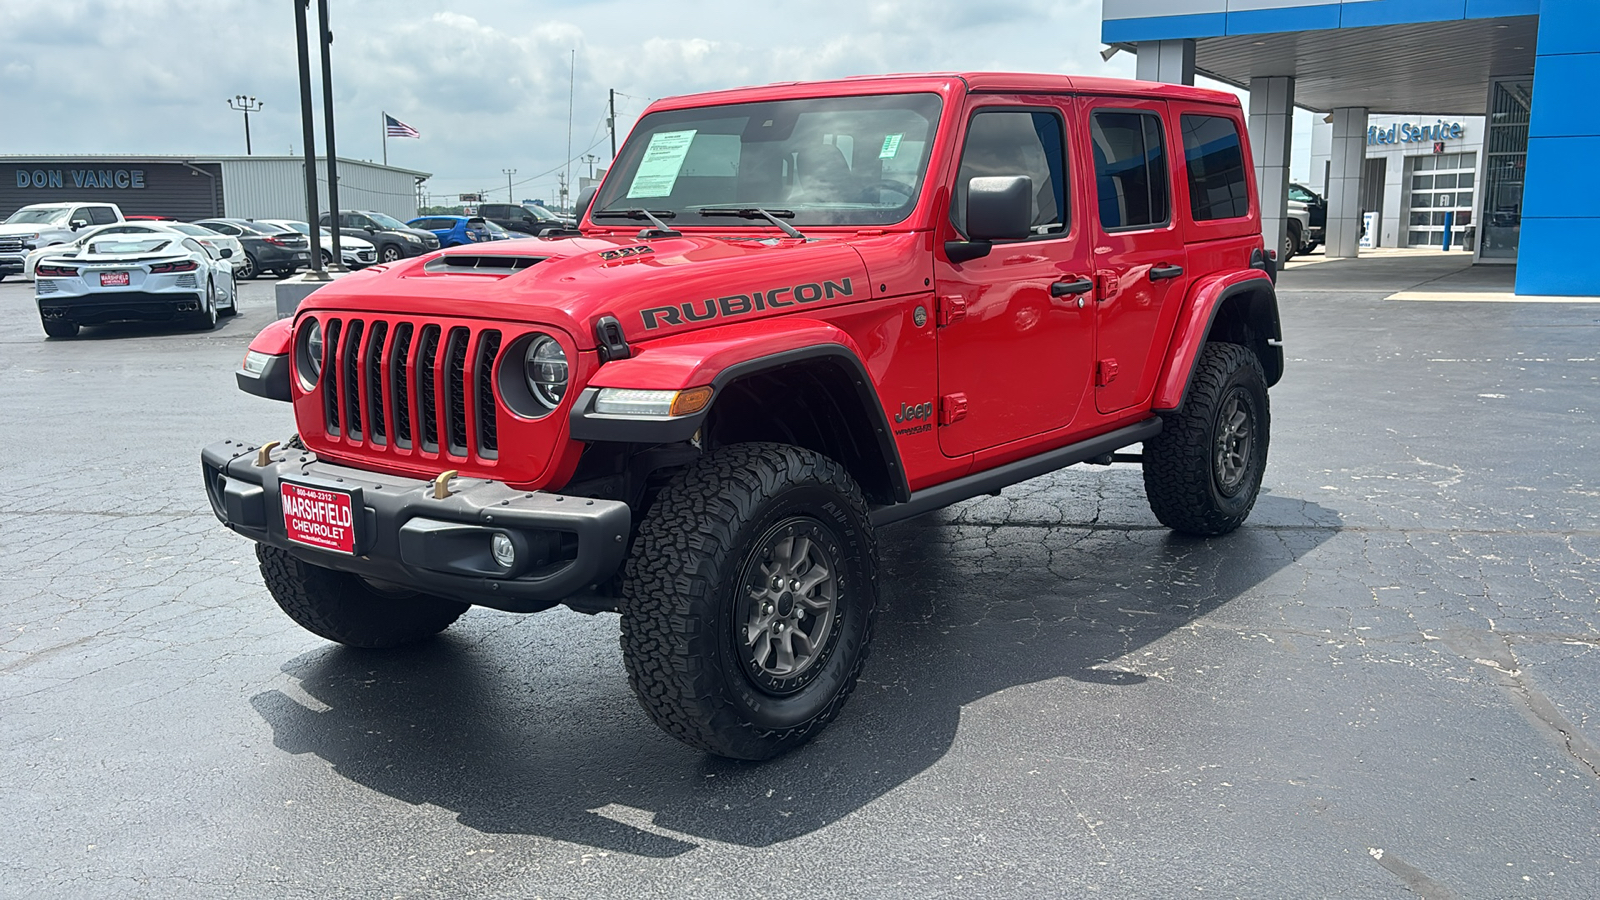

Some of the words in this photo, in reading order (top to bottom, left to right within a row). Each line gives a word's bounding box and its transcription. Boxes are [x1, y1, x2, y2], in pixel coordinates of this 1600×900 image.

[1401, 119, 1461, 143] Service
[16, 169, 63, 188] DON
[71, 169, 145, 189] VANCE
[640, 277, 854, 331] RUBICON
[895, 401, 933, 424] Jeep
[296, 488, 332, 501] 800-440-2312
[283, 494, 351, 527] MARSHFIELD
[292, 518, 344, 540] CHEVROLET
